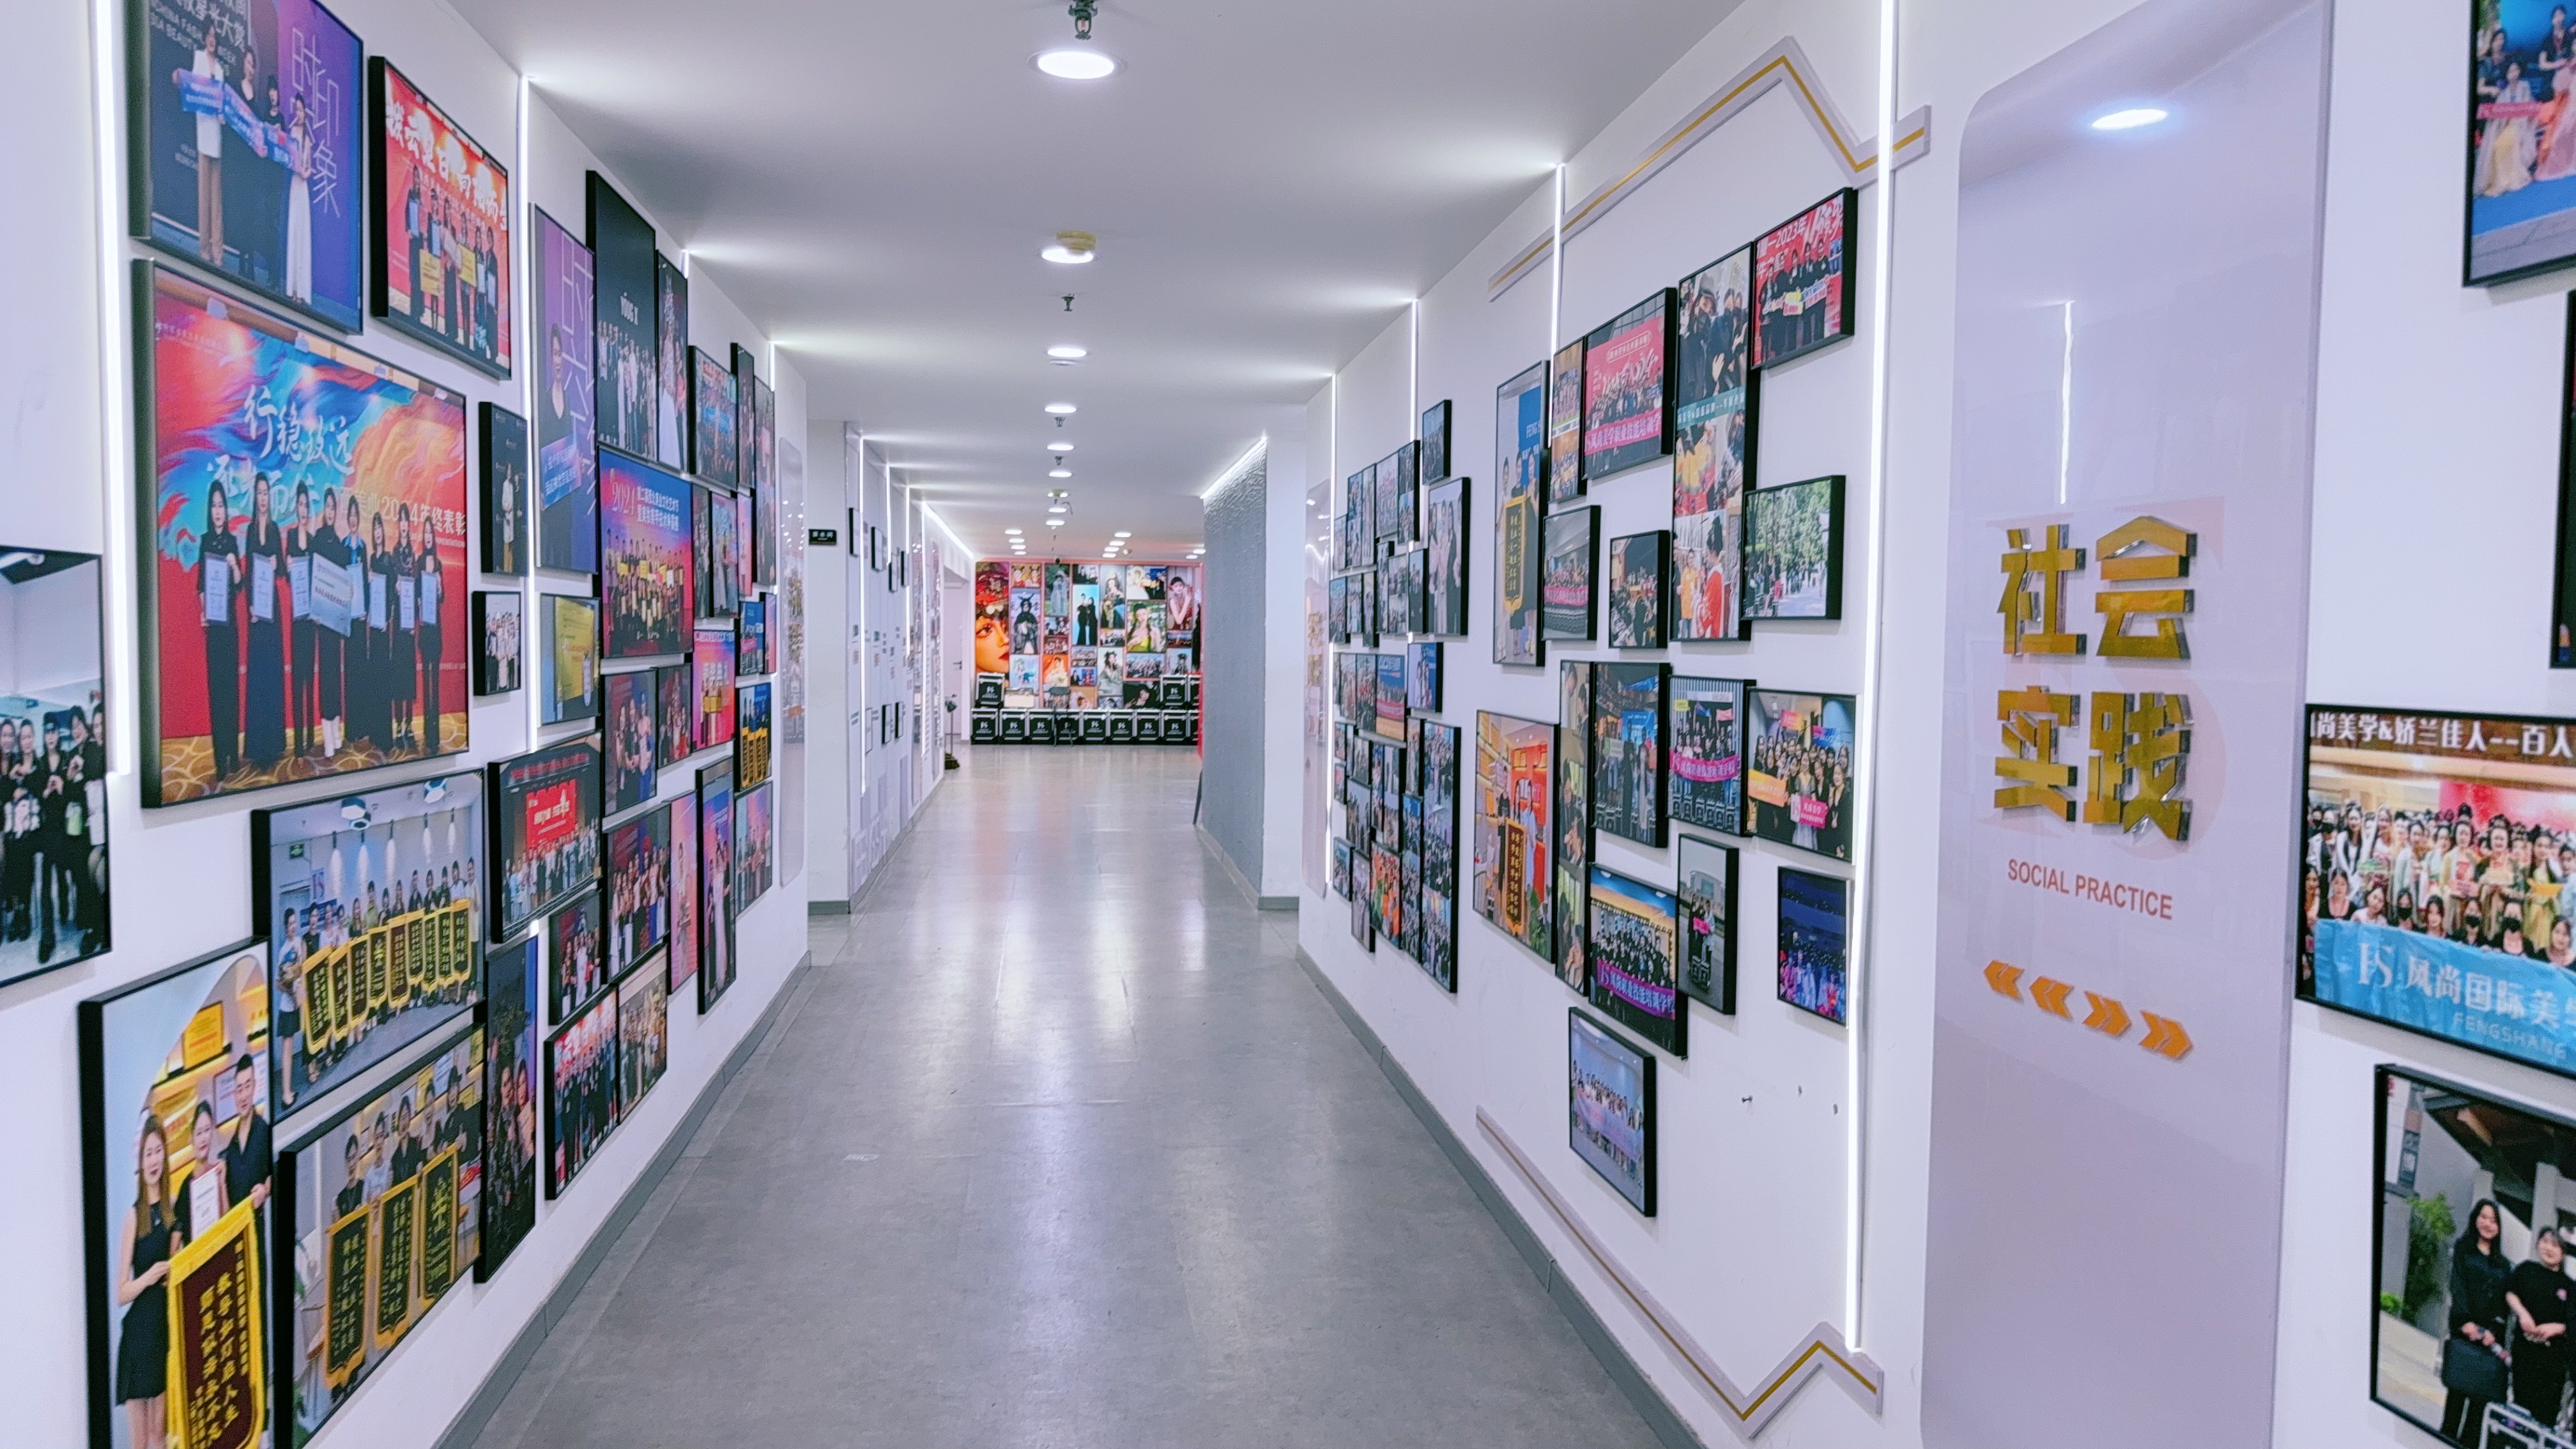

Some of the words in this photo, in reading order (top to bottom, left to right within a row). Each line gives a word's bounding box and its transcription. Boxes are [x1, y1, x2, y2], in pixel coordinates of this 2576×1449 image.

[1997, 516, 2198, 661] 社会
[1993, 685, 2196, 843] 实践
[2008, 859, 2069, 894] SOCIAL
[2075, 873, 2173, 920] PRACTICE
